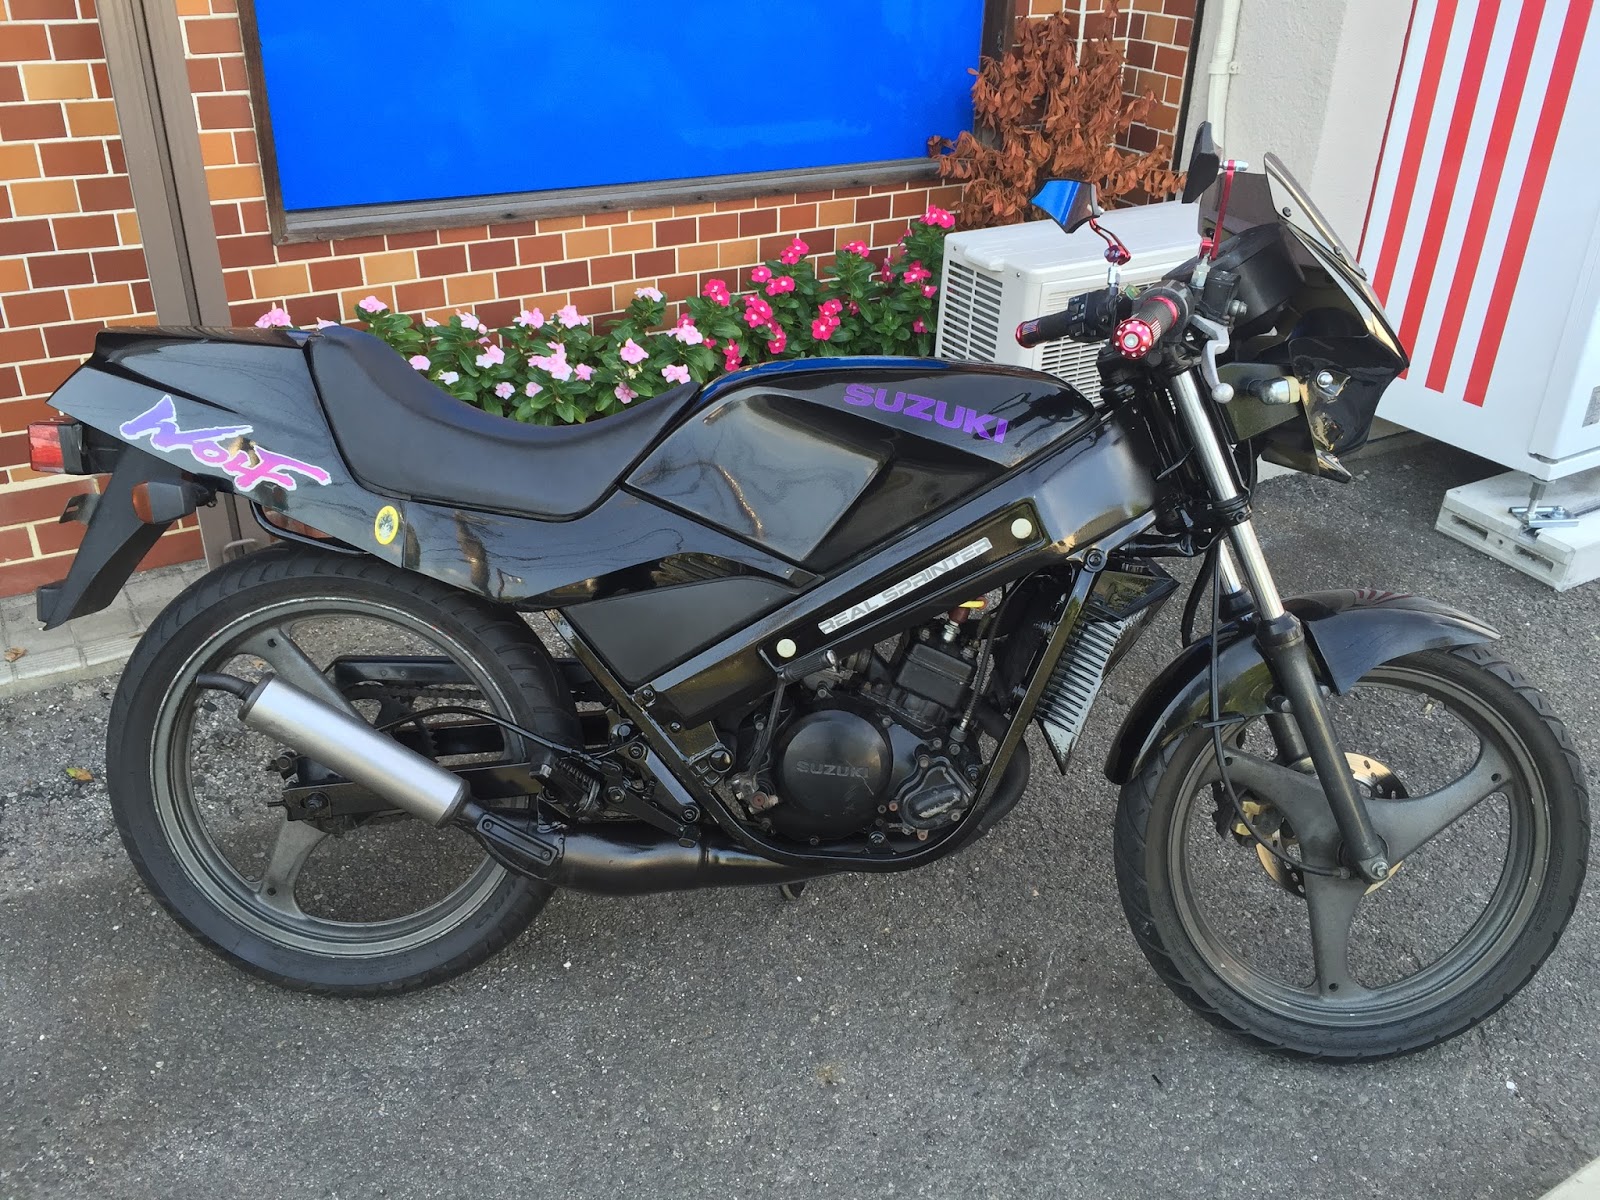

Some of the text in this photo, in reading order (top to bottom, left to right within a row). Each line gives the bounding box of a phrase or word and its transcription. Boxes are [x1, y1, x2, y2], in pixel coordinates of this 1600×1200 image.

[844, 383, 1007, 443] SUZUKI
[819, 540, 991, 633] REAL SPRINTER
[796, 760, 869, 778] SUZUKI
